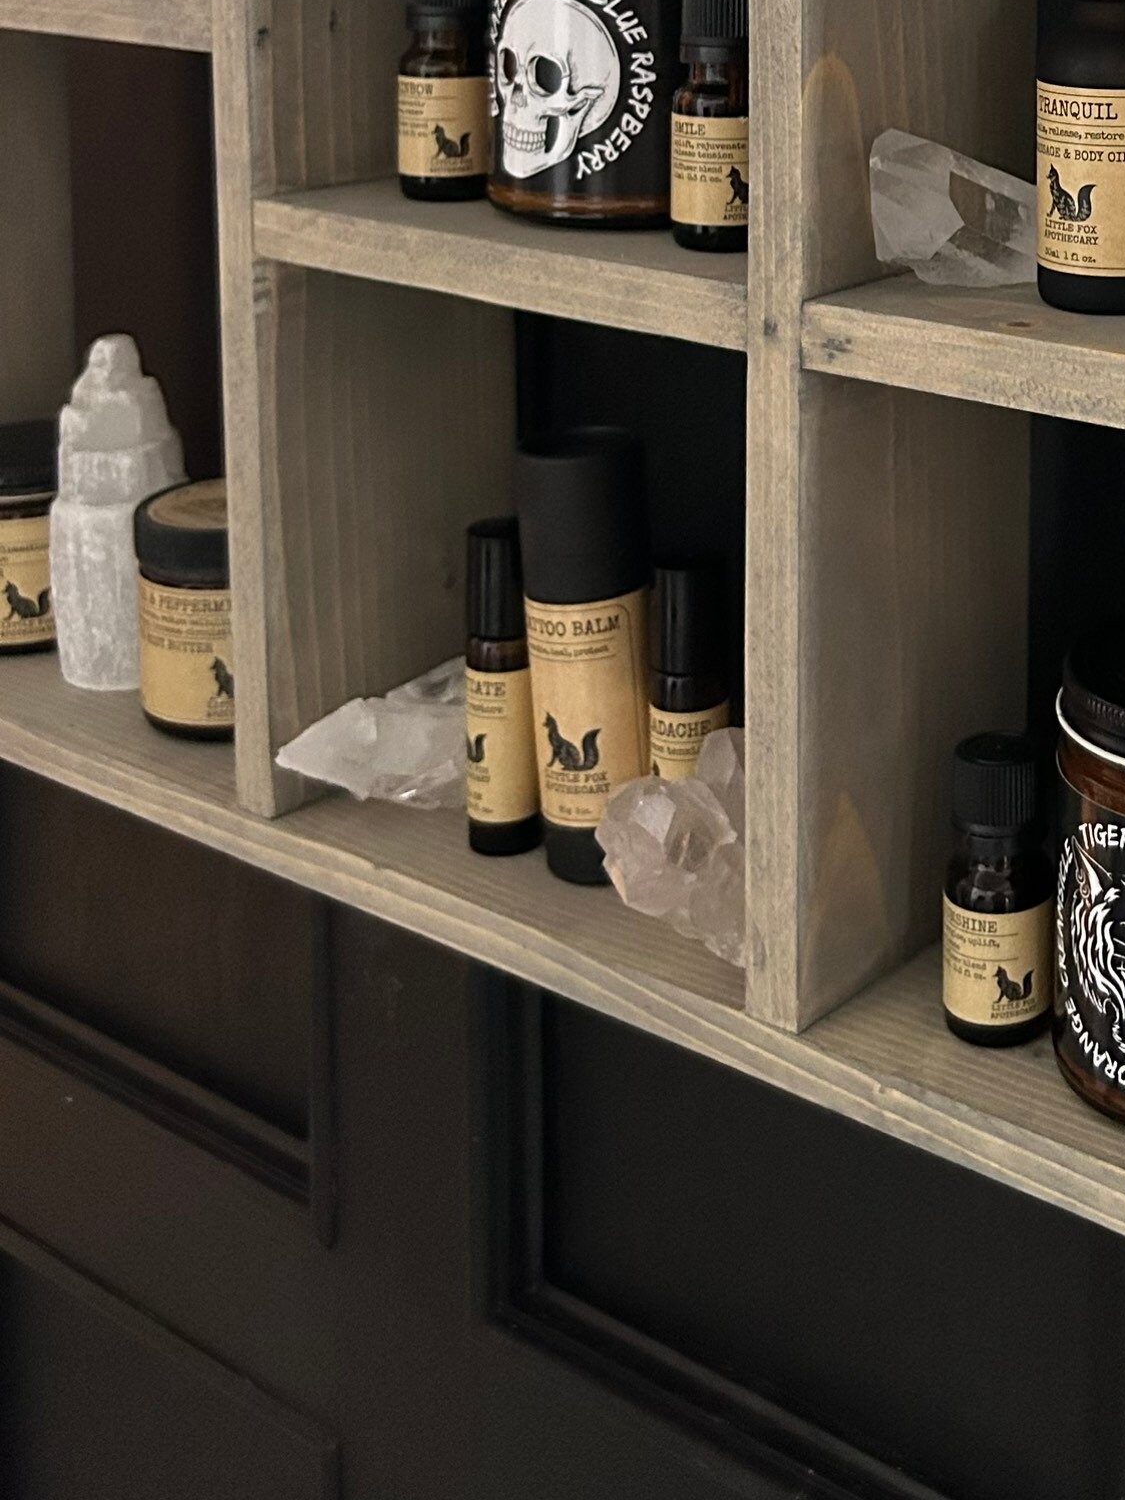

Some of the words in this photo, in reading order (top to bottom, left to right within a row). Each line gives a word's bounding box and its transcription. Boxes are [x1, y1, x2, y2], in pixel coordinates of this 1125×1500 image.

[576, 51, 657, 180] RASPBERRY
[1039, 95, 1118, 121] TRANQUIL
[674, 121, 706, 136] SMILE
[1048, 127, 1082, 140] release,
[1084, 131, 1125, 141] restore
[696, 142, 747, 152] rejuvenate
[698, 151, 734, 160] tension
[1063, 148, 1071, 159] &
[1074, 149, 1104, 162] BODY
[1045, 218, 1075, 232] LITTLE
[1077, 224, 1098, 235] FOX
[1044, 229, 1099, 246] APOTHECARY
[571, 614, 620, 637] BALM
[947, 905, 998, 933] SHINE
[1057, 838, 1073, 987] CREAMSICLE
